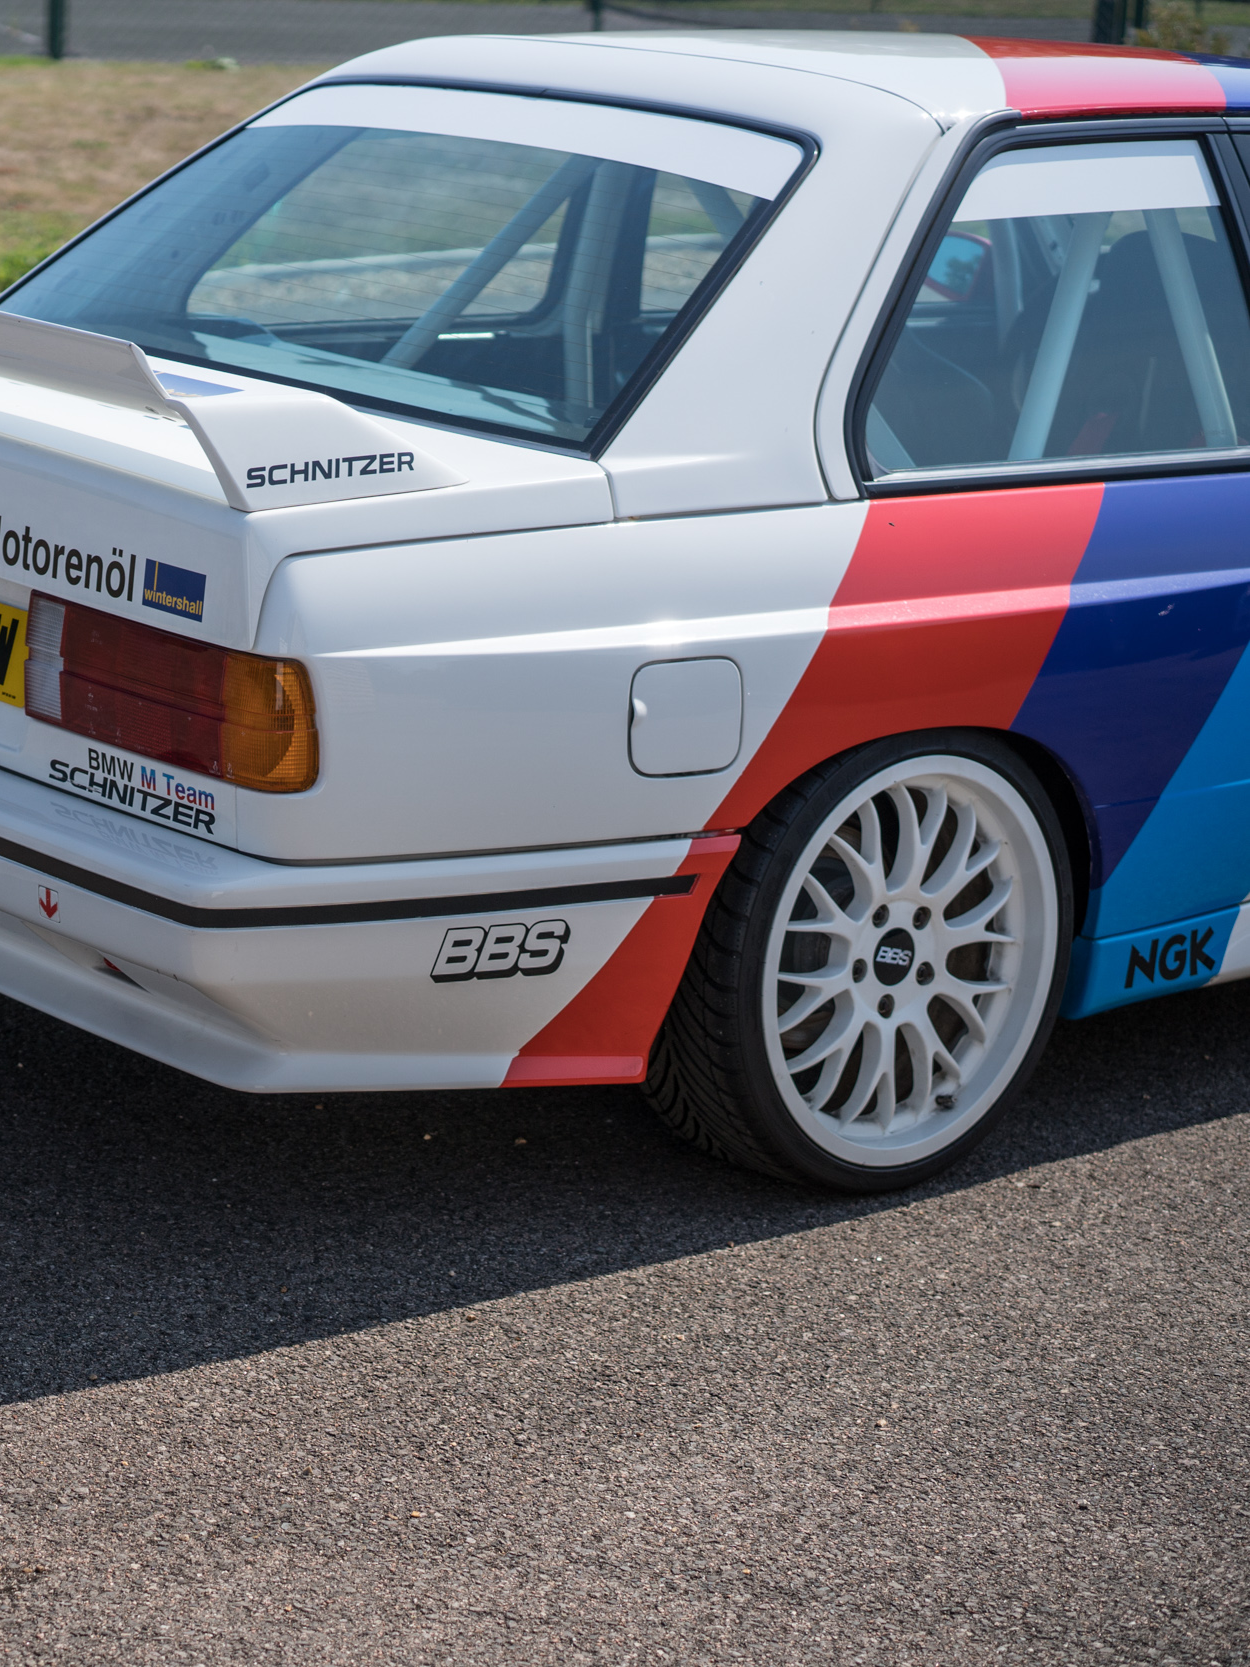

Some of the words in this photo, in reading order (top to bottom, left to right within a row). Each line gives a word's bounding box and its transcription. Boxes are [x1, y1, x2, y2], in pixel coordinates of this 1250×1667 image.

[246, 451, 415, 489] SCHNITZER
[144, 588, 203, 616] wintershall
[48, 758, 217, 836] SCHNITZER
[87, 747, 135, 783] BMW
[140, 765, 157, 792] M
[162, 772, 216, 811] Team
[430, 918, 572, 984] BBS
[875, 945, 913, 967] BBS
[1123, 926, 1216, 989] NGK
